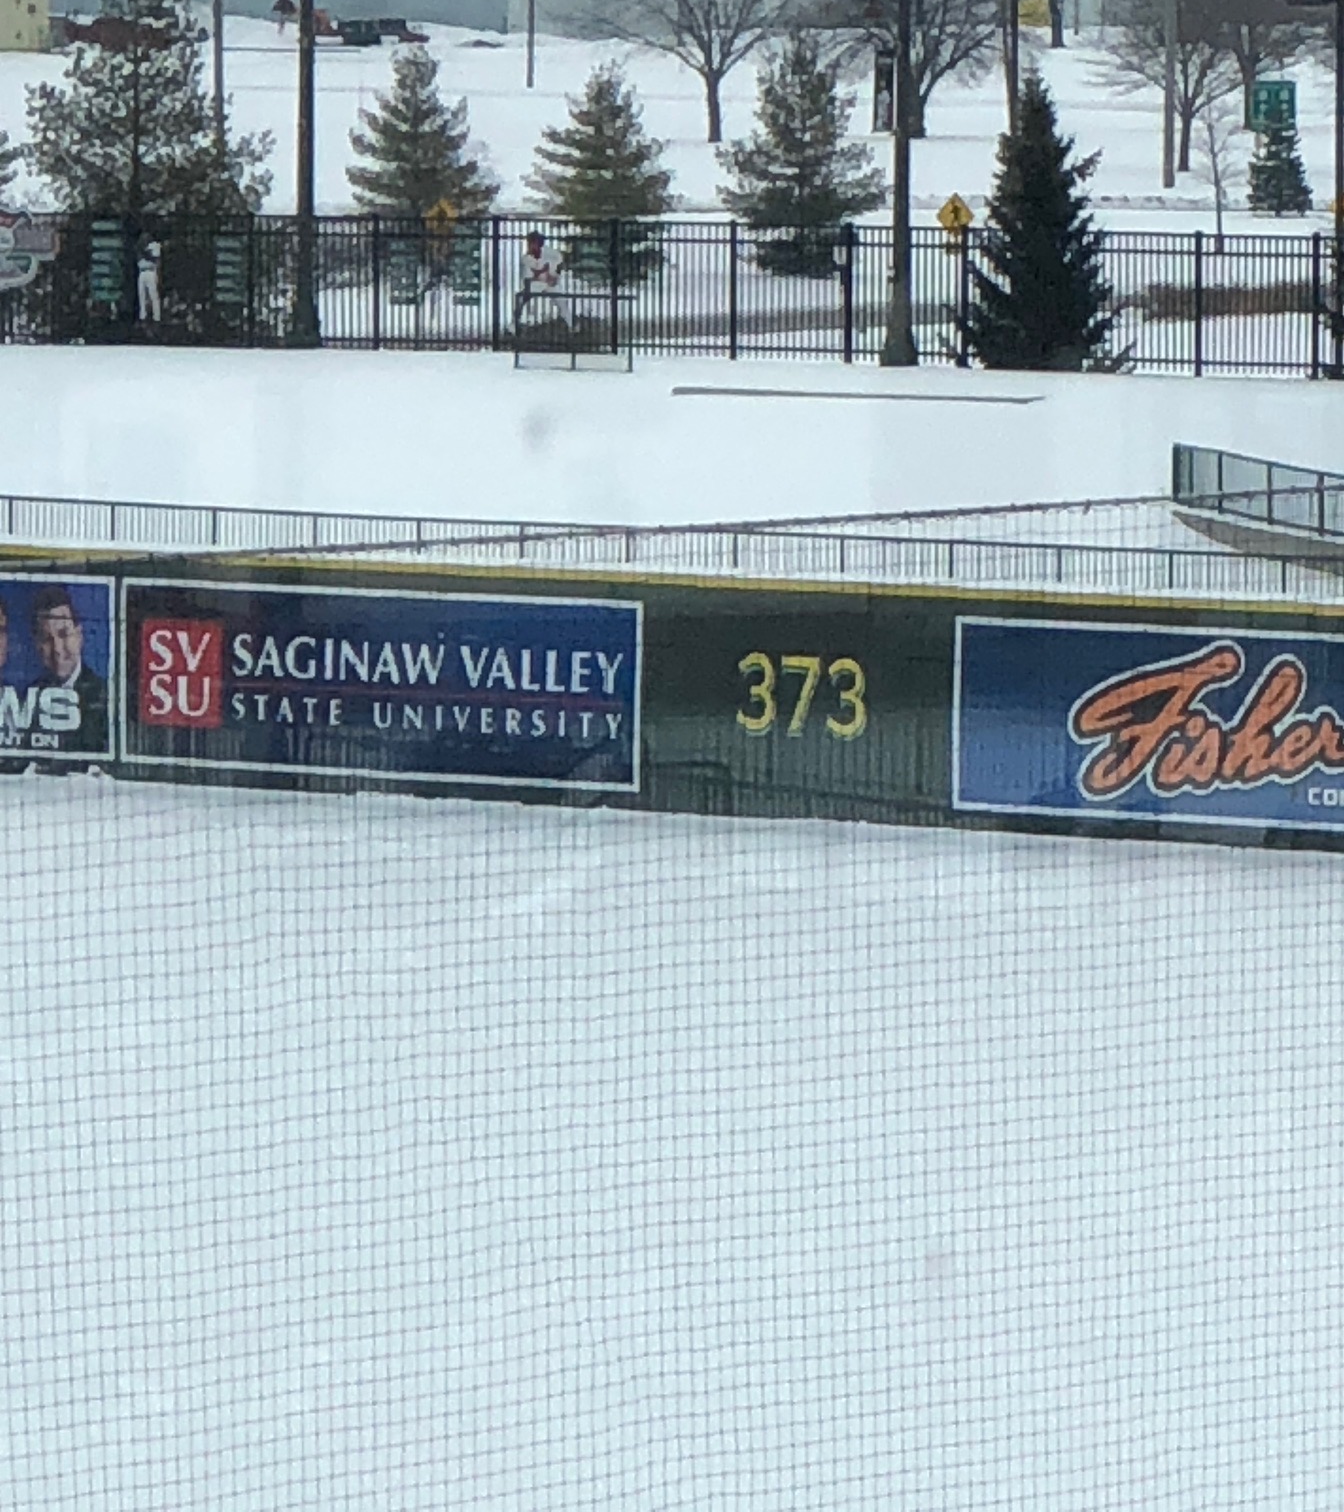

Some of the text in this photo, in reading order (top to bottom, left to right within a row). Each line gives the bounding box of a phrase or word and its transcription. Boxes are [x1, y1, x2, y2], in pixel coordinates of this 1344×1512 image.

[148, 629, 212, 673] SV
[231, 633, 625, 694] SAGINAW VALLEY
[148, 674, 211, 717] SU
[230, 692, 623, 740] STATE UNIVERSITY
[734, 650, 869, 741] 373
